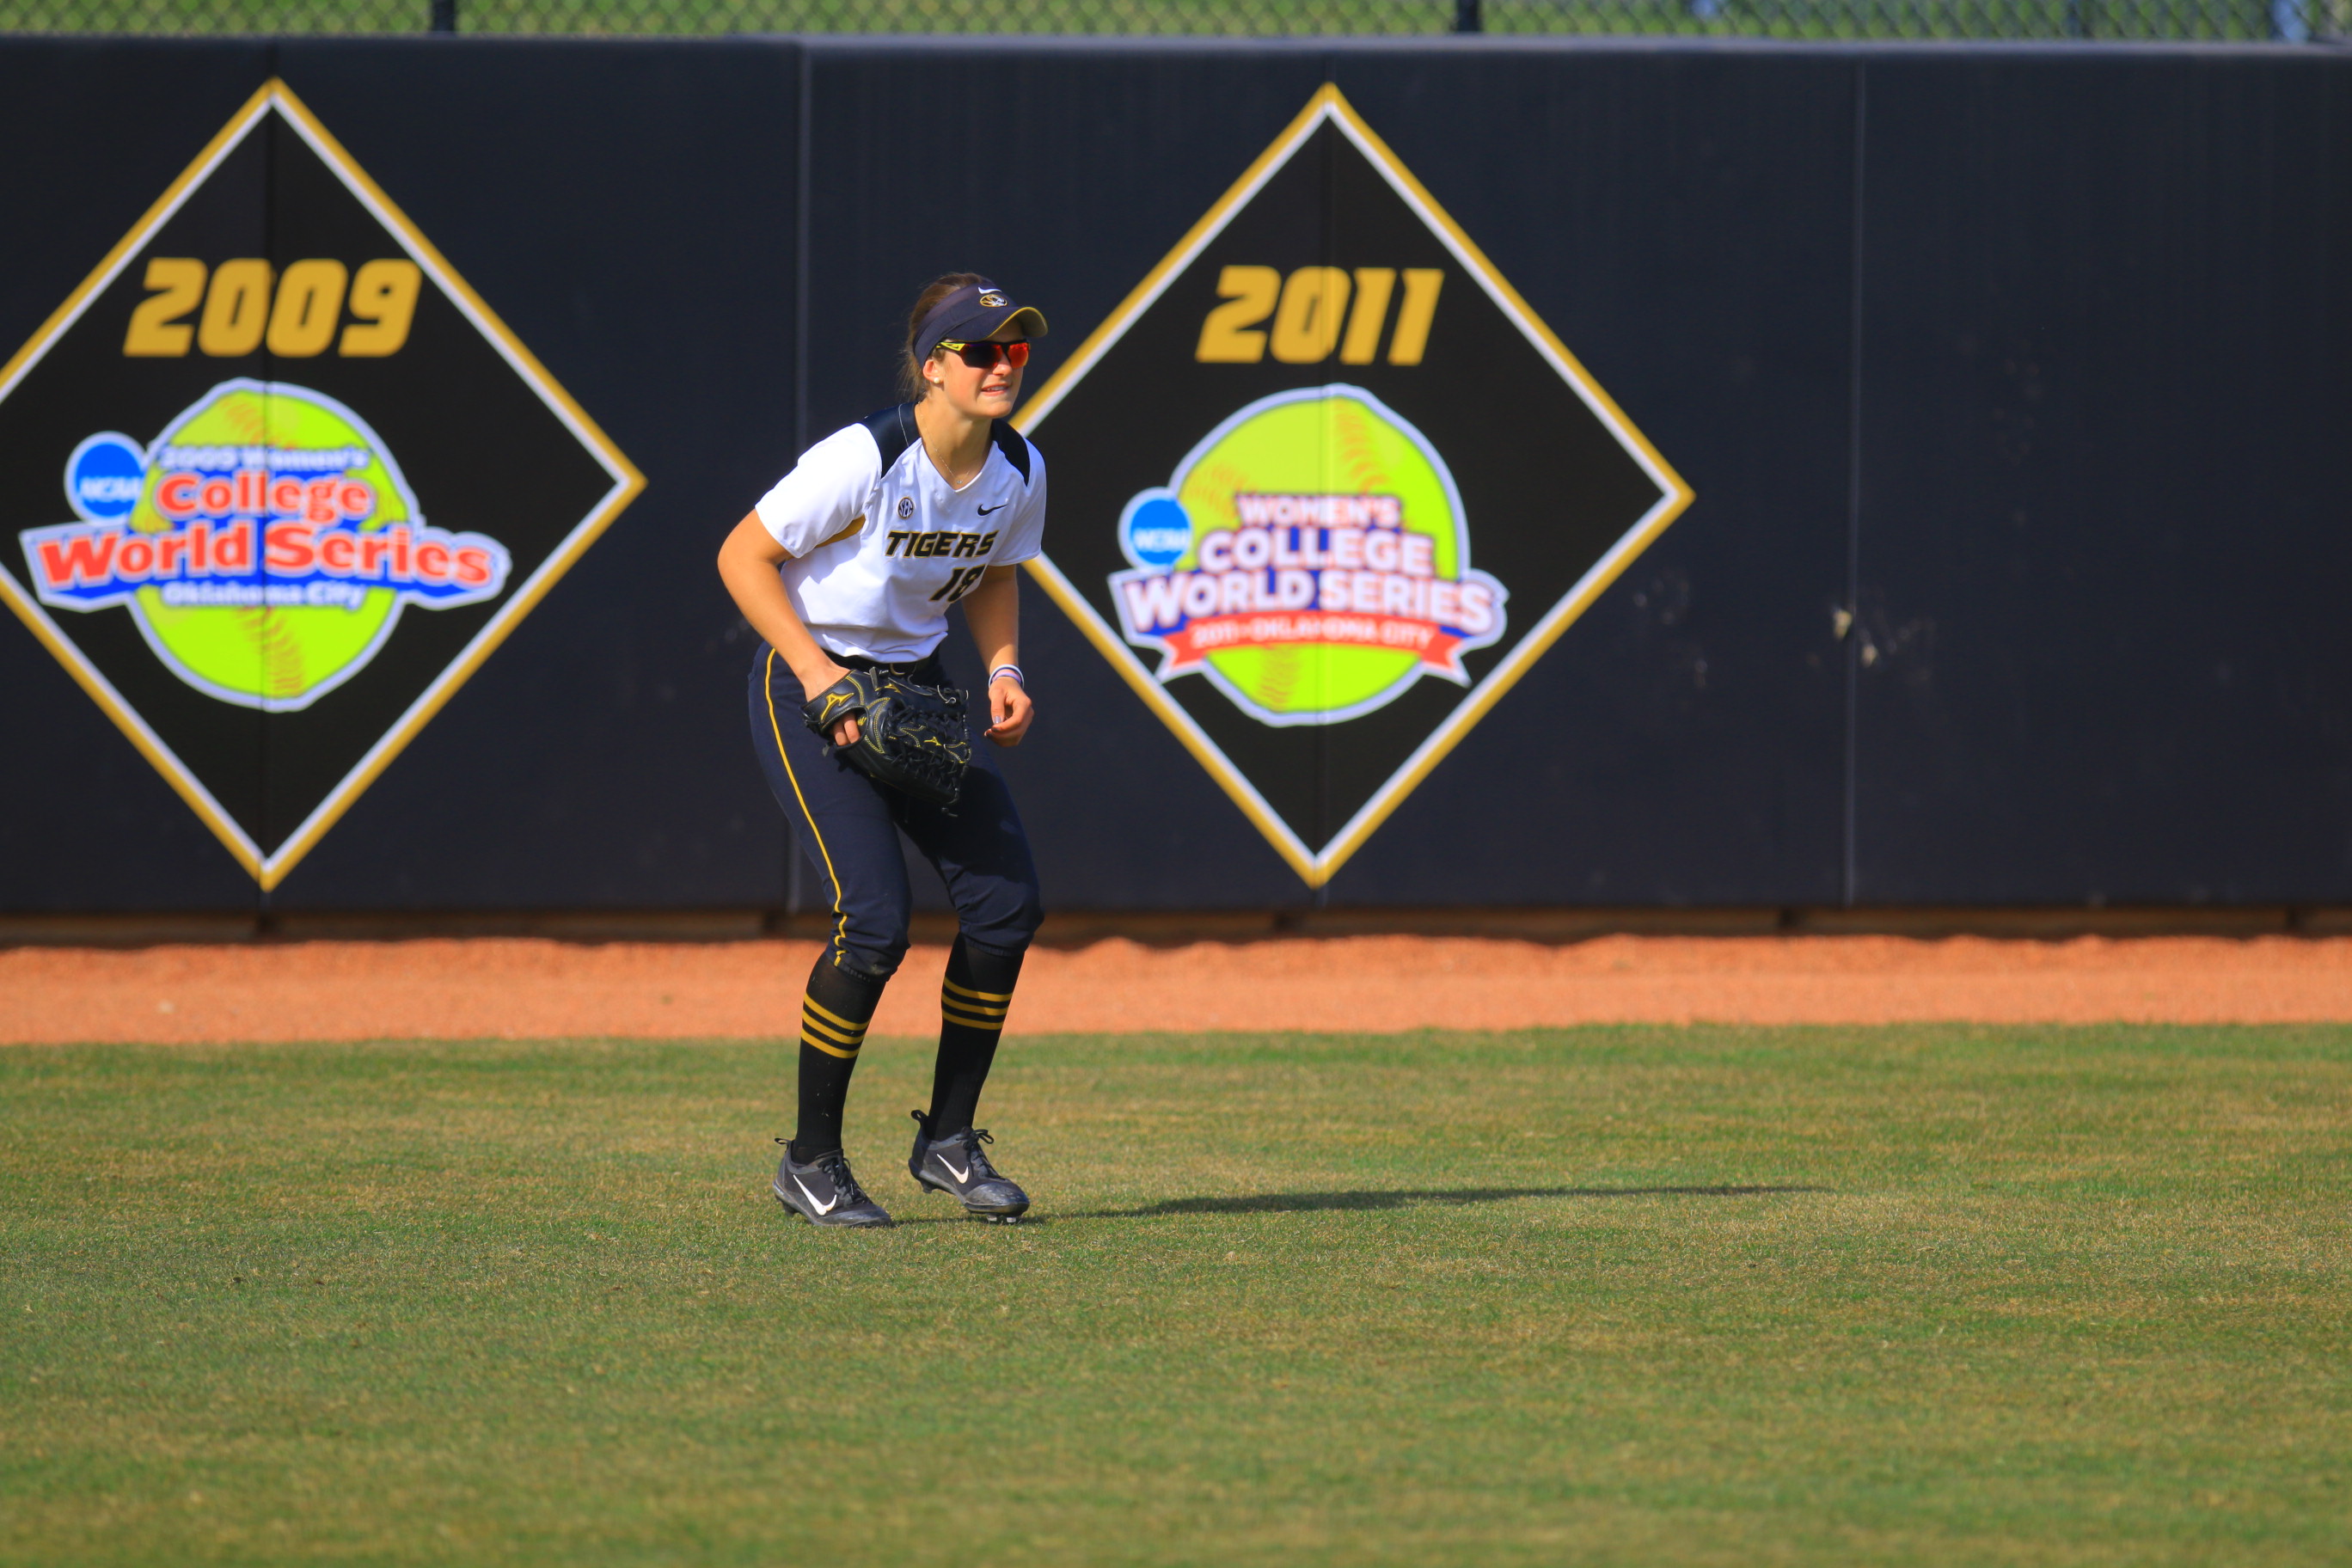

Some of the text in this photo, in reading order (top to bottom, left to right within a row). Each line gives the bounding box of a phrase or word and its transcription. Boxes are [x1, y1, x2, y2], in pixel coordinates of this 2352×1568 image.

[123, 258, 422, 357] 2009
[1195, 265, 1444, 365] 2011
[156, 472, 371, 524] College
[1236, 494, 1401, 528] WOMEN'S
[38, 523, 491, 585] World Series
[885, 529, 999, 558] TIGERS
[1199, 526, 1434, 577] COLLEGE
[1126, 570, 1495, 634] WORLD SERIES
